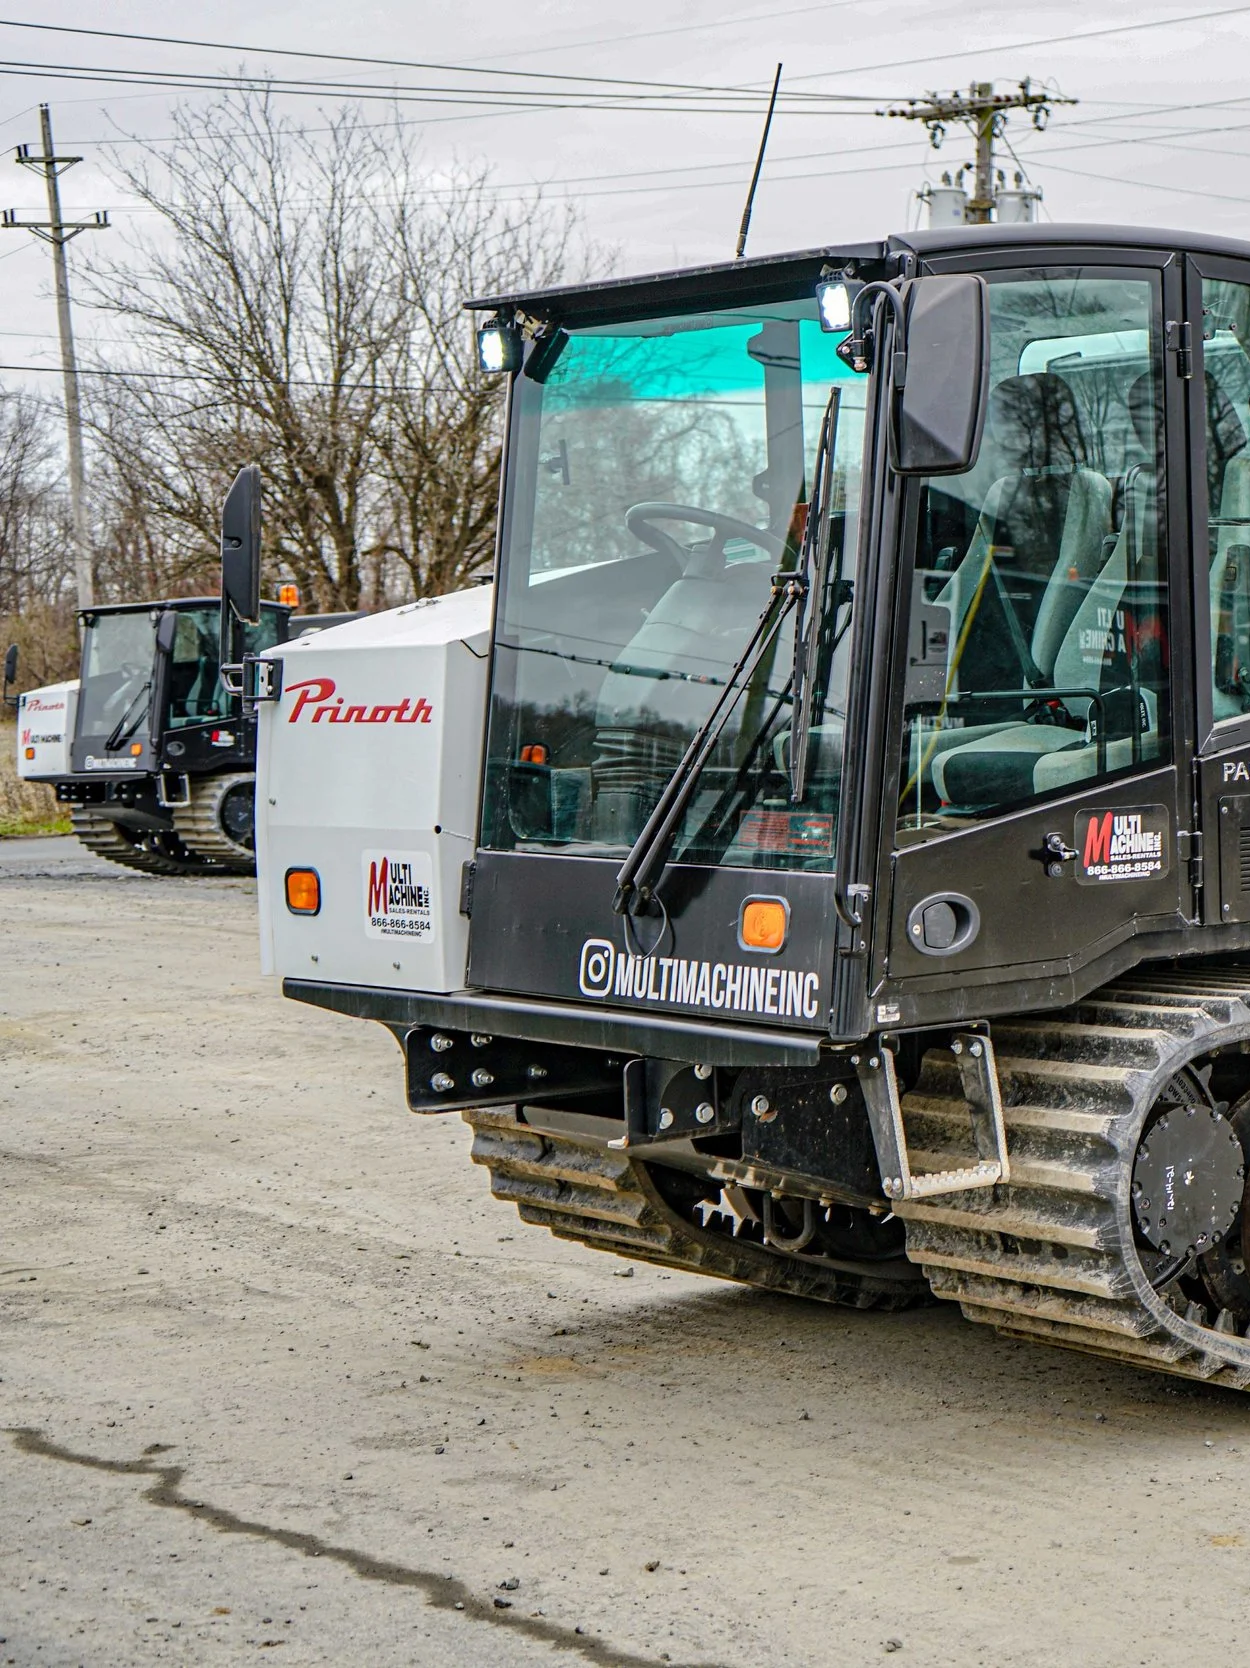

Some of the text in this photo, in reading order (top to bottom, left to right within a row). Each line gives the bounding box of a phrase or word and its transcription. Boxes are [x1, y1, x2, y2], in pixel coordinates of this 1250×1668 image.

[27, 699, 65, 712] Prinoth
[285, 678, 433, 723] Prinoth
[1087, 860, 1162, 876] 866-866-8584
[371, 917, 431, 931] 866-866-8584
[614, 953, 819, 1019] MULTIMACHINEINC
